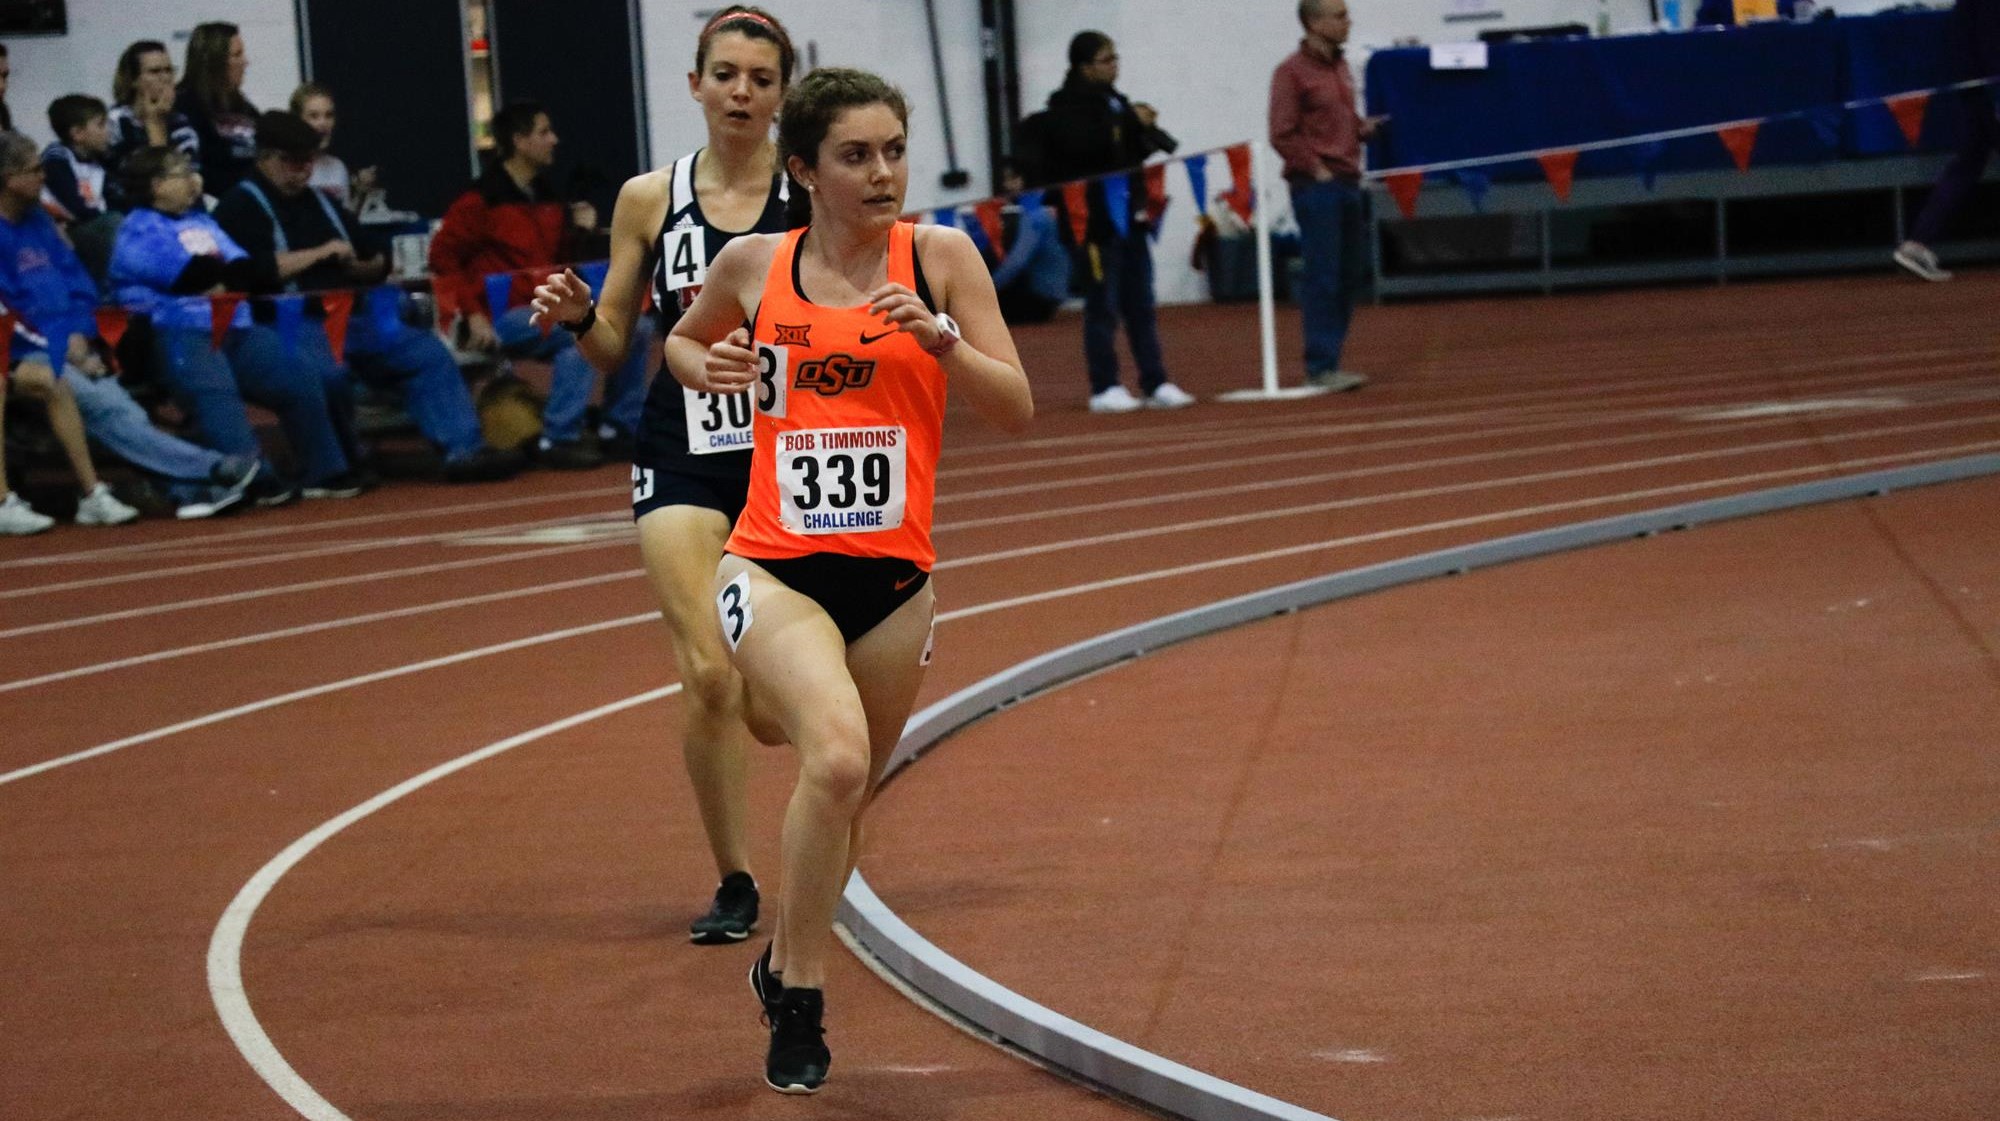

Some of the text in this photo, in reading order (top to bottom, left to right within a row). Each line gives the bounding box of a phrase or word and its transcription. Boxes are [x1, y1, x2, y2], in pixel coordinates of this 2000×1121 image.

[671, 232, 698, 283] 4
[757, 346, 777, 412] 3
[793, 353, 876, 396] OSU
[698, 391, 752, 432] 30
[709, 430, 753, 448] CHALLE
[785, 429, 897, 451] BOB TIMMONS
[791, 452, 891, 510] 339
[803, 511, 883, 529] CHALLENGE
[722, 582, 745, 644] 3
